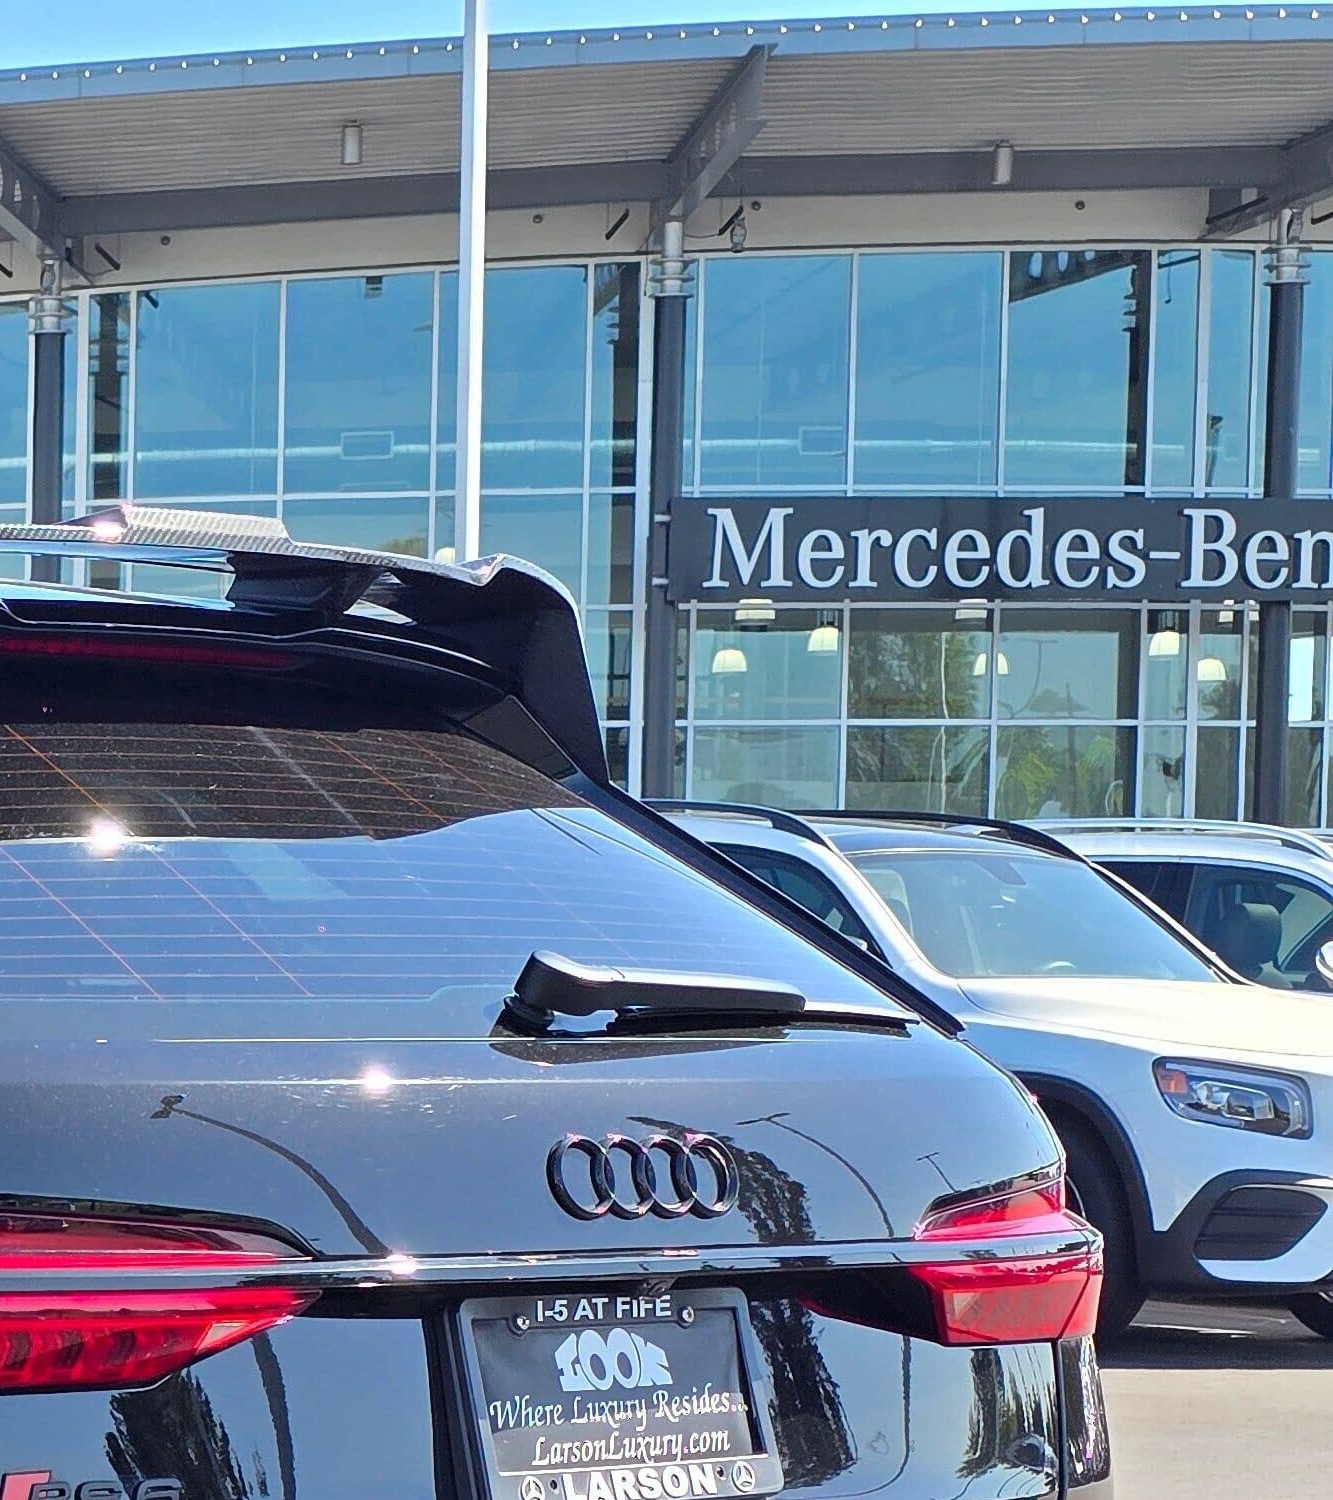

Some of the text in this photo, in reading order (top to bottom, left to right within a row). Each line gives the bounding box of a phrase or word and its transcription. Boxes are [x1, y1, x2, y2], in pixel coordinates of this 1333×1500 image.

[536, 1294, 673, 1322] I-5 AT FIFE
[489, 1394, 565, 1429] Where
[570, 1395, 647, 1432] Luxury
[531, 1428, 731, 1466] LarsonLuxury.com
